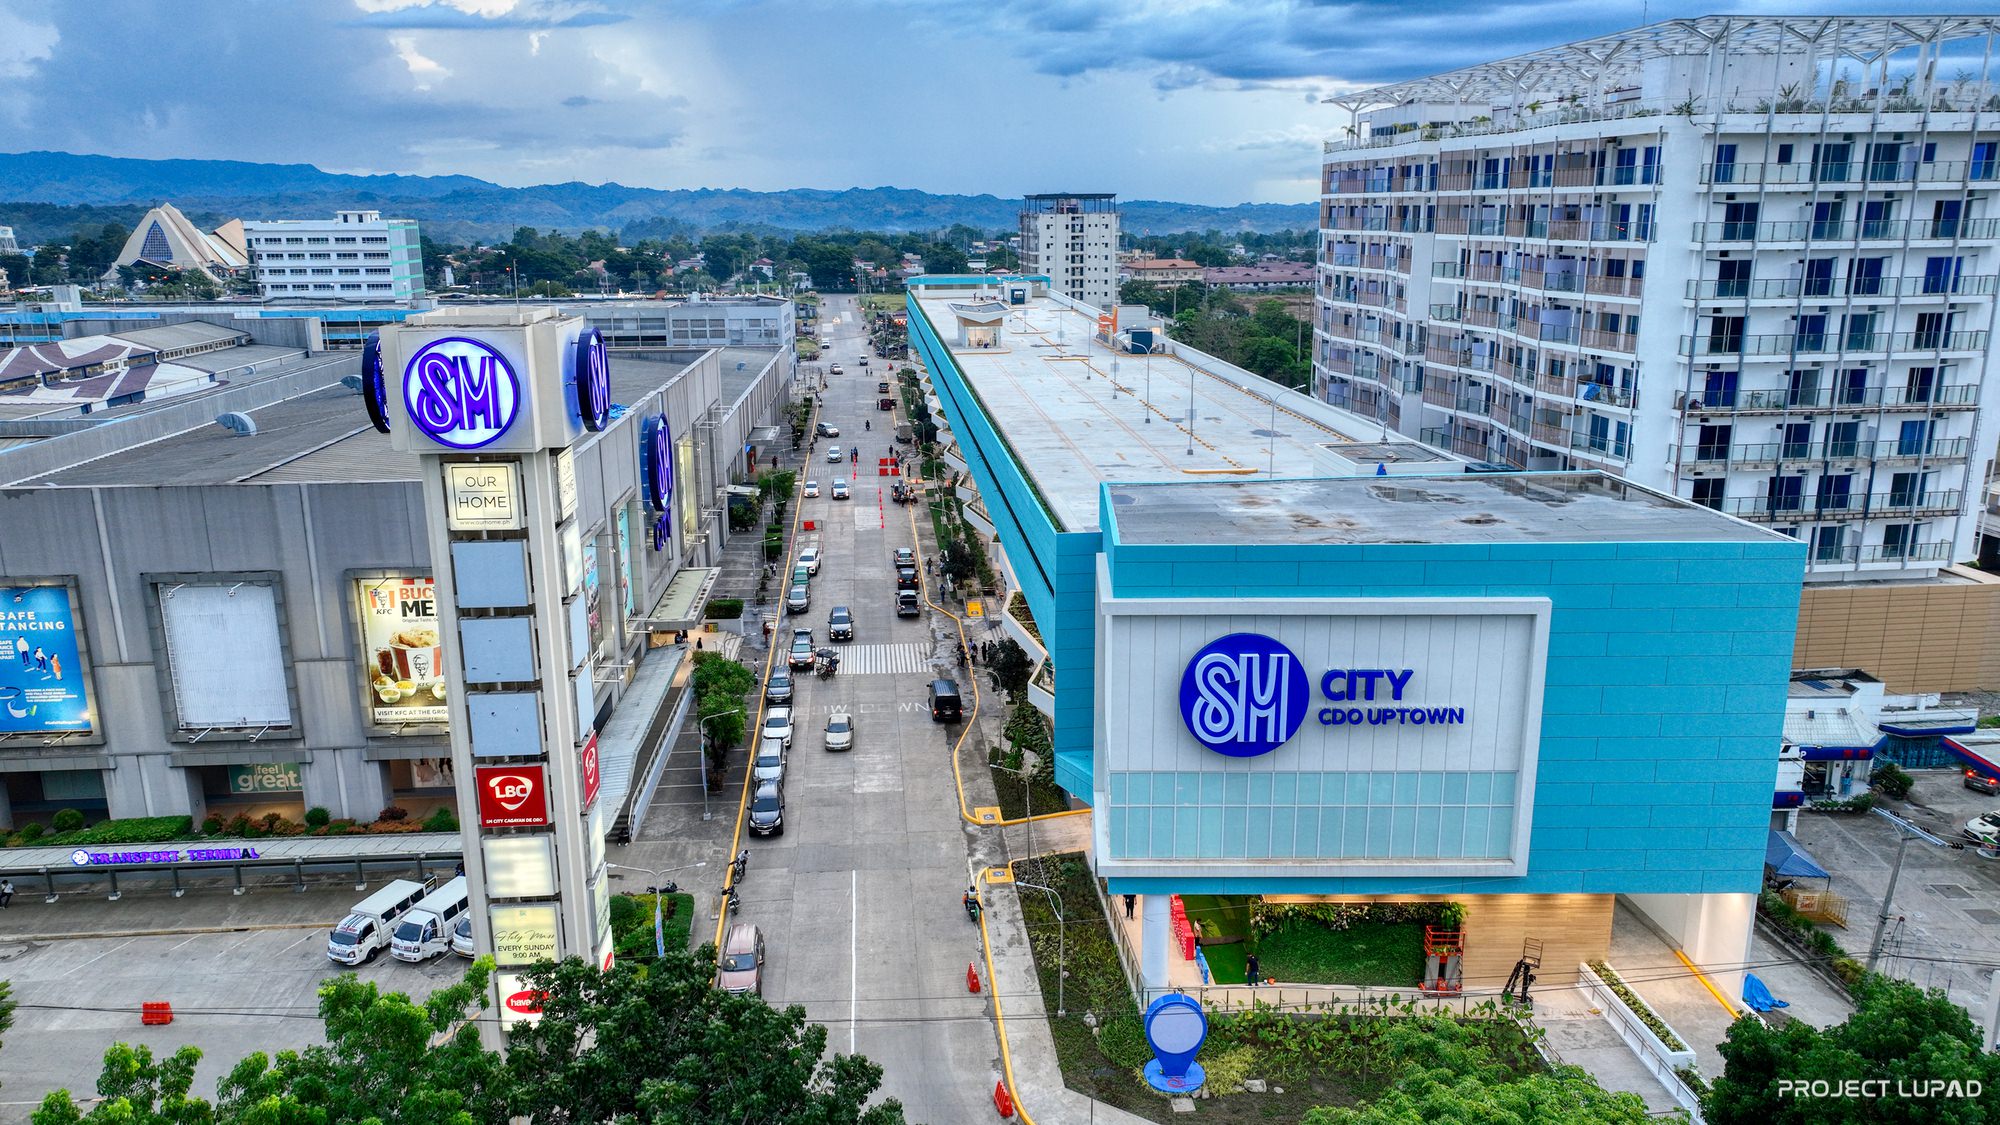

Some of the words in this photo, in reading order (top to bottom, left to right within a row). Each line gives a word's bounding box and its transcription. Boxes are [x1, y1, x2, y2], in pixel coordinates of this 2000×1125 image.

[417, 352, 503, 434] SM
[465, 476, 497, 488] OUR
[458, 496, 507, 509] HOME
[399, 587, 436, 600] BUC
[401, 600, 438, 617] ME
[0, 611, 36, 621] SAFE
[1320, 669, 1414, 701] CITY
[1192, 652, 1290, 744] SM
[1318, 708, 1364, 726] CDO
[1366, 706, 1465, 725] UPTOWN
[257, 765, 279, 775] feel
[495, 785, 528, 799] LBC
[90, 850, 179, 865] TRANSPORT
[186, 848, 260, 862] TERMINAL
[494, 930, 522, 942] Holy
[524, 929, 555, 941] Mass
[510, 998, 533, 1007] hava
